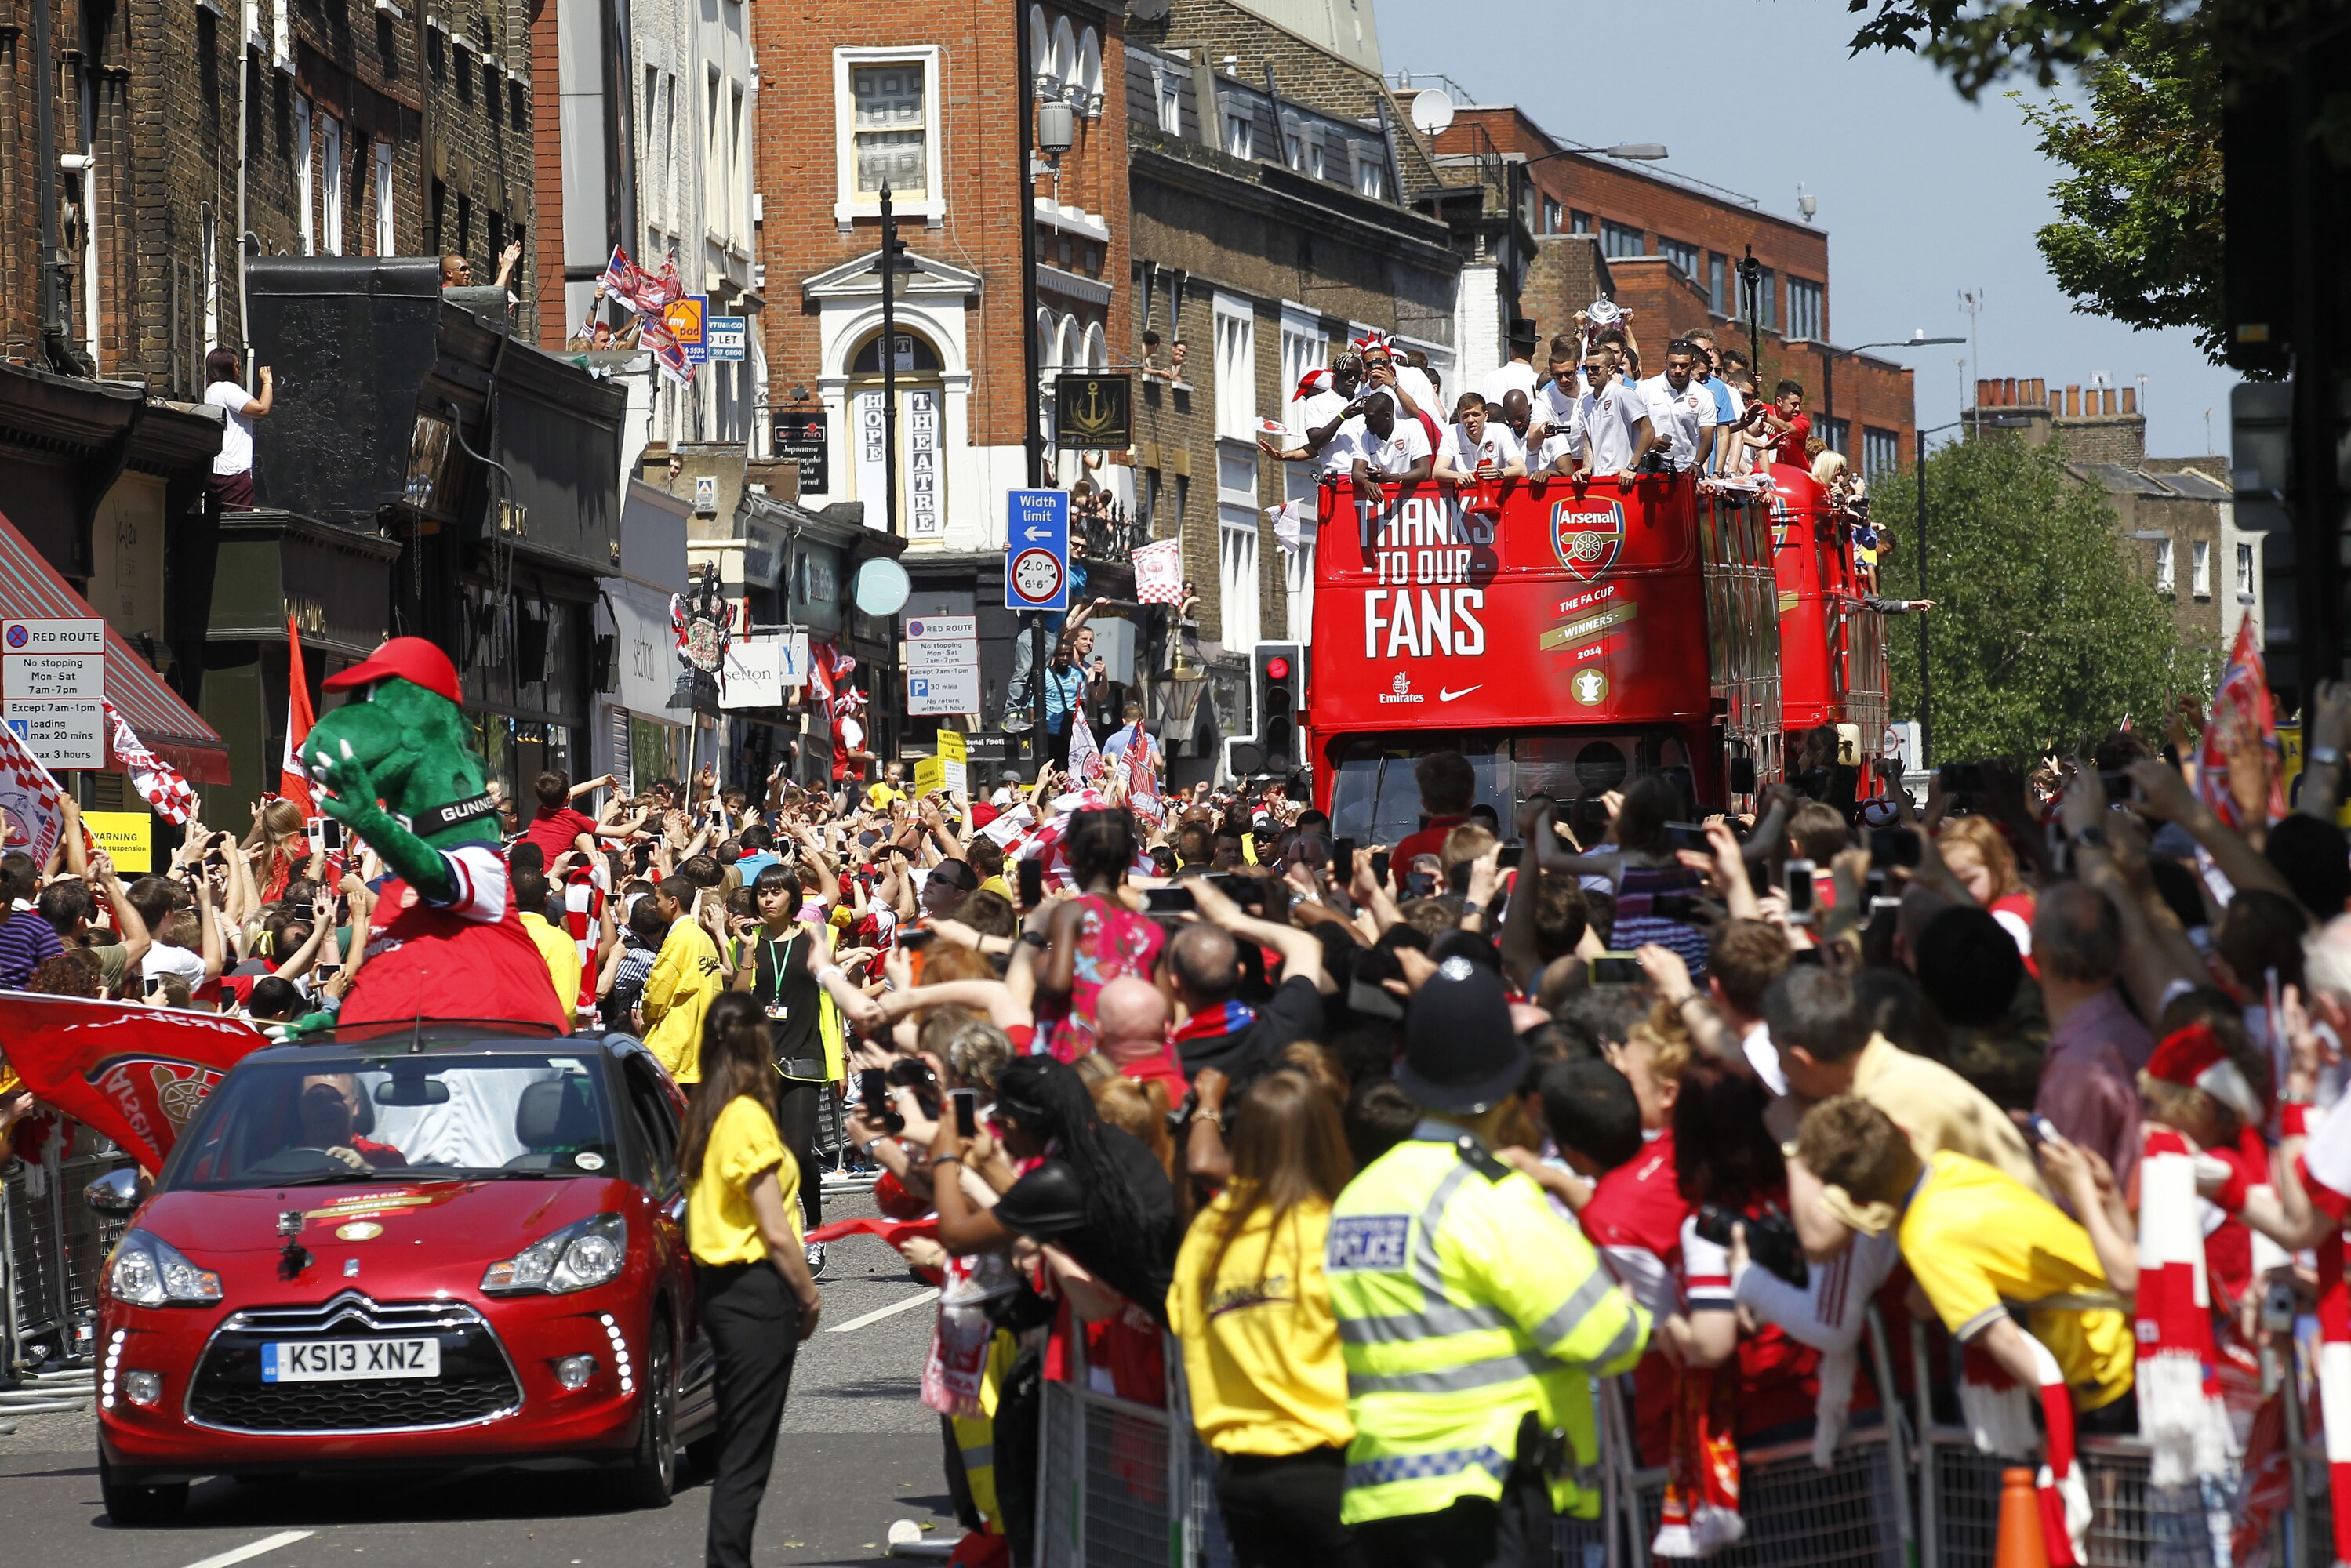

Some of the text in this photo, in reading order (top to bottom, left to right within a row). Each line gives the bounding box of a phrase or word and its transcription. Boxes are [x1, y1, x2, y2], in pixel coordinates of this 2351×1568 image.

[668, 318, 686, 328] my
[681, 328, 699, 338] pad
[719, 335, 737, 343] LET
[864, 394, 882, 463] HOPE
[912, 392, 936, 533] THEATRE
[1019, 495, 1056, 508] Width
[1023, 510, 1052, 521] limit
[1354, 495, 1495, 547] THANKS
[1560, 510, 1615, 524] Arsenal
[1379, 550, 1472, 585] TO OUR
[1559, 586, 1615, 612] THE FA CUP
[1364, 588, 1485, 659] FANS
[1564, 613, 1613, 639] WINNERS
[32, 632, 100, 641] RED ROUTE
[1577, 645, 1601, 660] 2014
[24, 659, 83, 669] No stopping
[1379, 693, 1424, 704] Emirates
[12, 703, 45, 713] Except
[30, 720, 66, 729] loading
[54, 731, 67, 740] 20
[71, 731, 93, 740] mins
[53, 750, 61, 759] 3
[64, 750, 92, 759] hours
[441, 796, 495, 822] GUNNE
[1332, 1236, 1404, 1265] POLICE
[289, 1343, 357, 1373] KS13
[366, 1340, 425, 1370] XNZ
